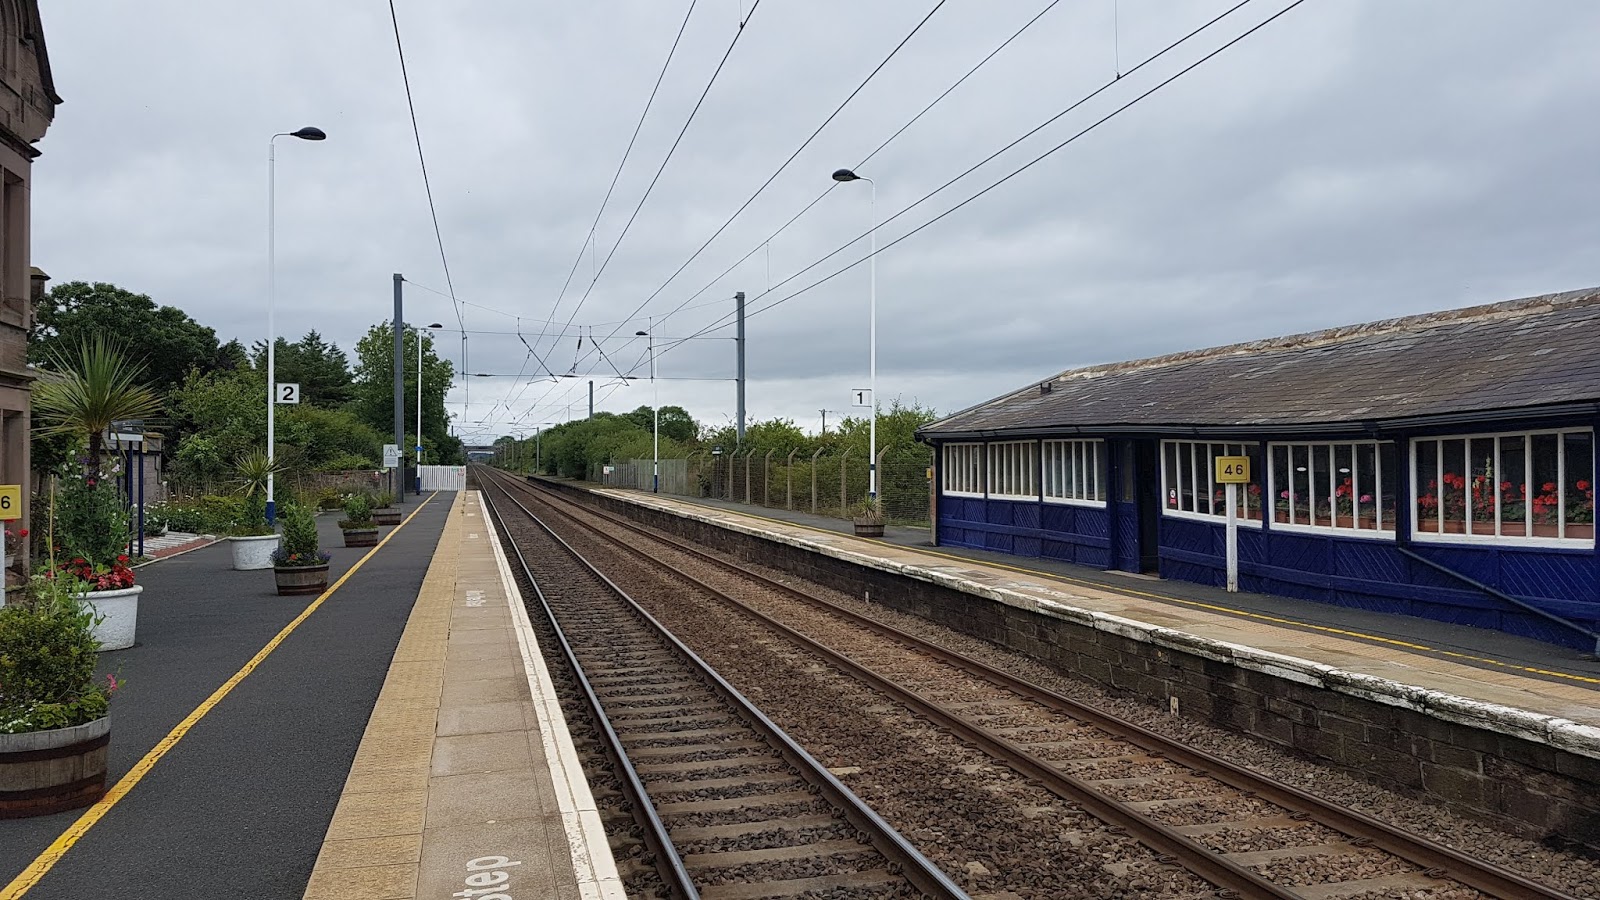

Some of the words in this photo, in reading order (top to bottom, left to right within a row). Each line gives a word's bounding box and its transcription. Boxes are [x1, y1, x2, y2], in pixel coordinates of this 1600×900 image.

[282, 386, 294, 401] 2
[856, 391, 863, 405] 1
[1224, 464, 1244, 475] 46
[1, 495, 11, 509] 6
